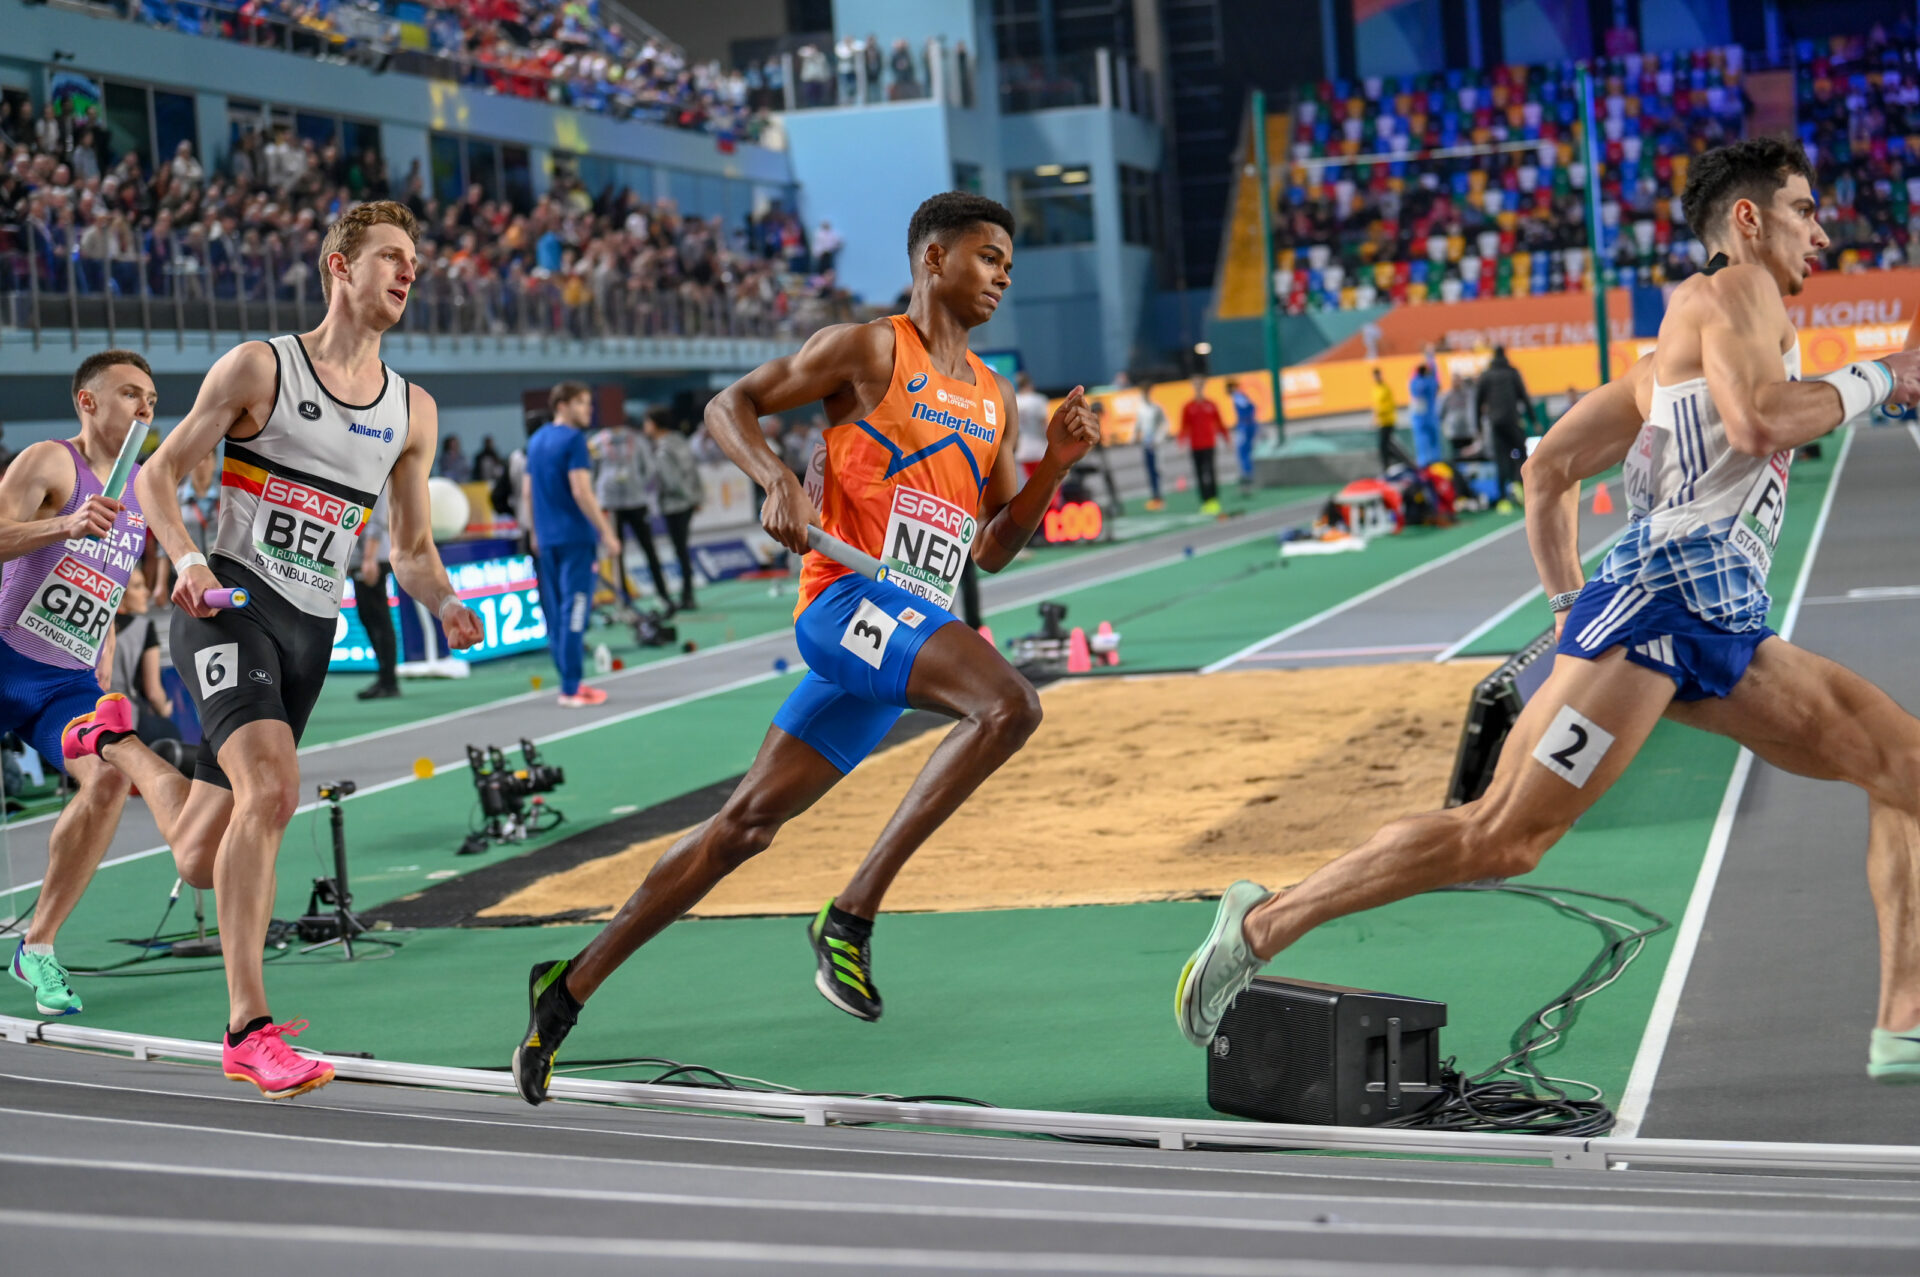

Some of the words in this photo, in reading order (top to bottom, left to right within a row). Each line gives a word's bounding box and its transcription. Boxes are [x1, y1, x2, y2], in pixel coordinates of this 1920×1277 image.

[1811, 299, 1902, 328] KORU
[348, 422, 382, 438] Allianz
[911, 402, 995, 444] Nederland
[267, 481, 342, 521] SPAR
[897, 493, 961, 534] SPAR
[1752, 477, 1784, 551] FR
[104, 528, 144, 553] EAT
[263, 509, 336, 567] BEL
[892, 521, 961, 583] NED
[255, 553, 310, 584] ISTANBUL
[311, 575, 334, 593] 2023
[270, 547, 275, 555] I
[276, 549, 298, 562] RUN
[298, 556, 322, 571] CLEAN
[900, 563, 905, 572] I
[906, 565, 926, 580] RUN
[926, 573, 946, 590] CLEAN
[58, 560, 112, 600] SPAR
[41, 583, 110, 641] GBR
[44, 611, 49, 619] I
[50, 614, 67, 630] RUN
[66, 622, 91, 642] CLEAN
[25, 615, 74, 650] ISTANBUL
[74, 643, 92, 660] 2023
[853, 619, 882, 650] 3
[206, 652, 226, 687] 6
[1549, 723, 1588, 772] 2
